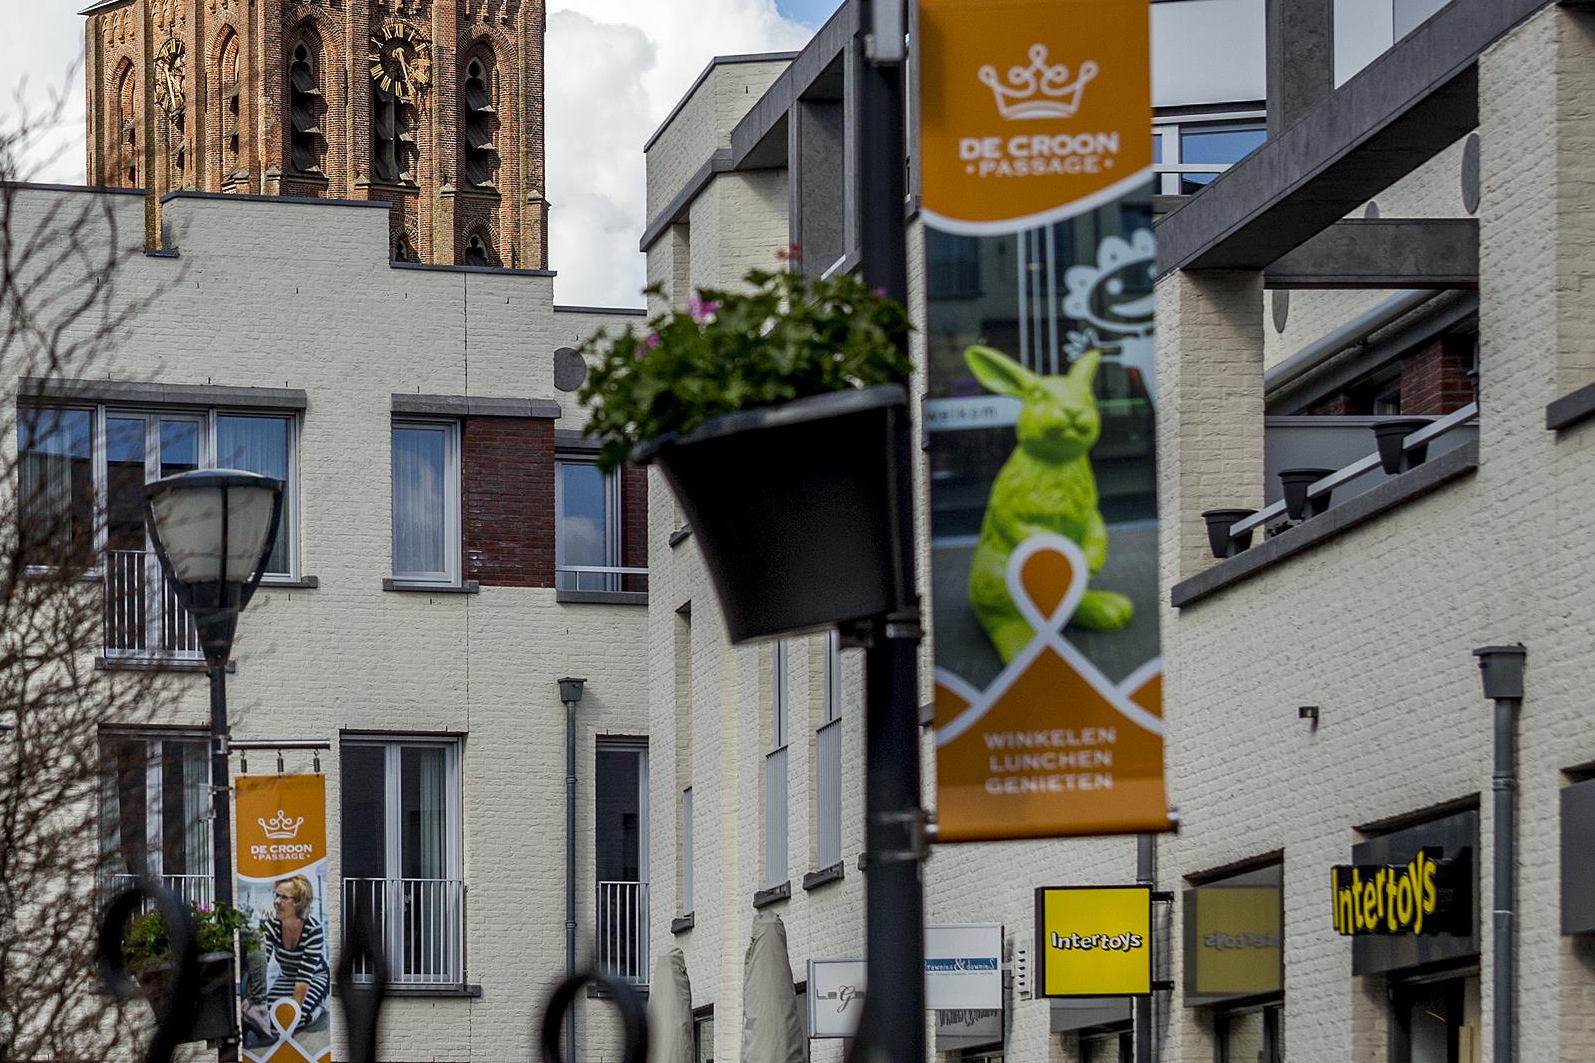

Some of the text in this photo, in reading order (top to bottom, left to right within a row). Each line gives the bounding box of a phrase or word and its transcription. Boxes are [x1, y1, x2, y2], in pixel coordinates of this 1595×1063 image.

[959, 131, 1120, 159] DE CROON
[979, 155, 1100, 177] PASSAGE
[983, 727, 1116, 749] WINKELEN
[989, 750, 1112, 772] LUNCHEN
[985, 773, 1112, 794] GENIETEN
[250, 843, 312, 853] DE CROON
[258, 852, 304, 860] PASSAGE
[1331, 849, 1437, 935] Intertoys
[1051, 931, 1141, 951] Intertoys
